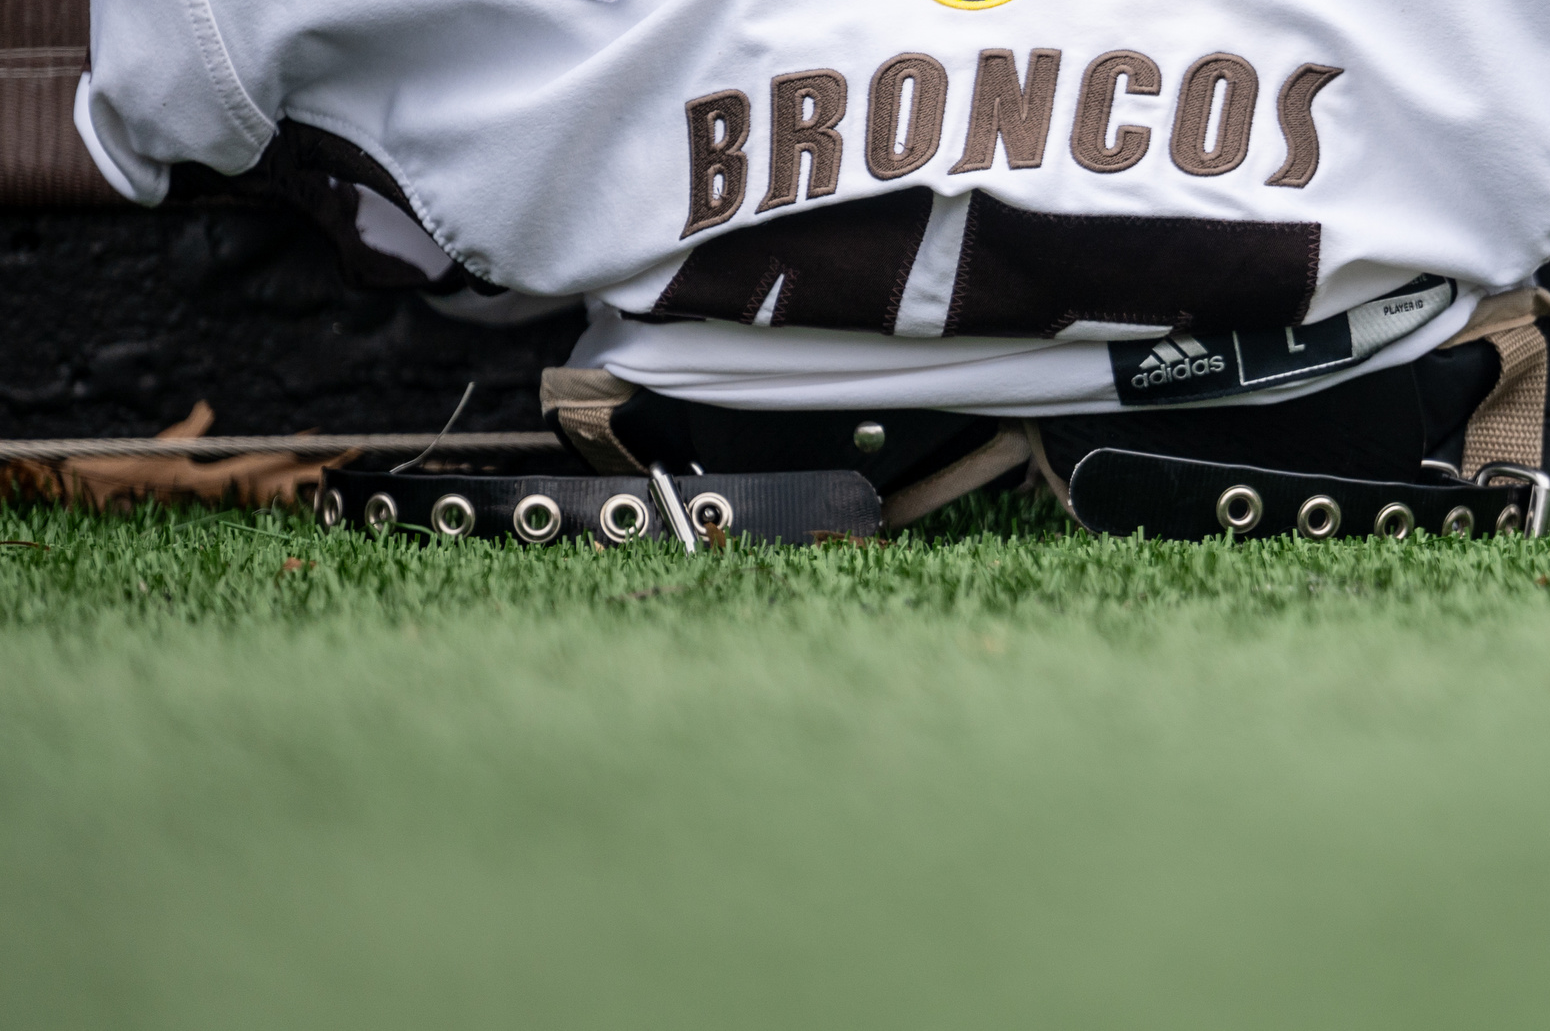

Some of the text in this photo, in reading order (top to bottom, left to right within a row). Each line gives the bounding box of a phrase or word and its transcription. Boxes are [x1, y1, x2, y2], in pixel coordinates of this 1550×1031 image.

[679, 47, 1345, 241] BRONCOS
[1383, 300, 1424, 316] PLAYER ID
[1285, 326, 1306, 354] L
[1131, 354, 1226, 390] adidas
